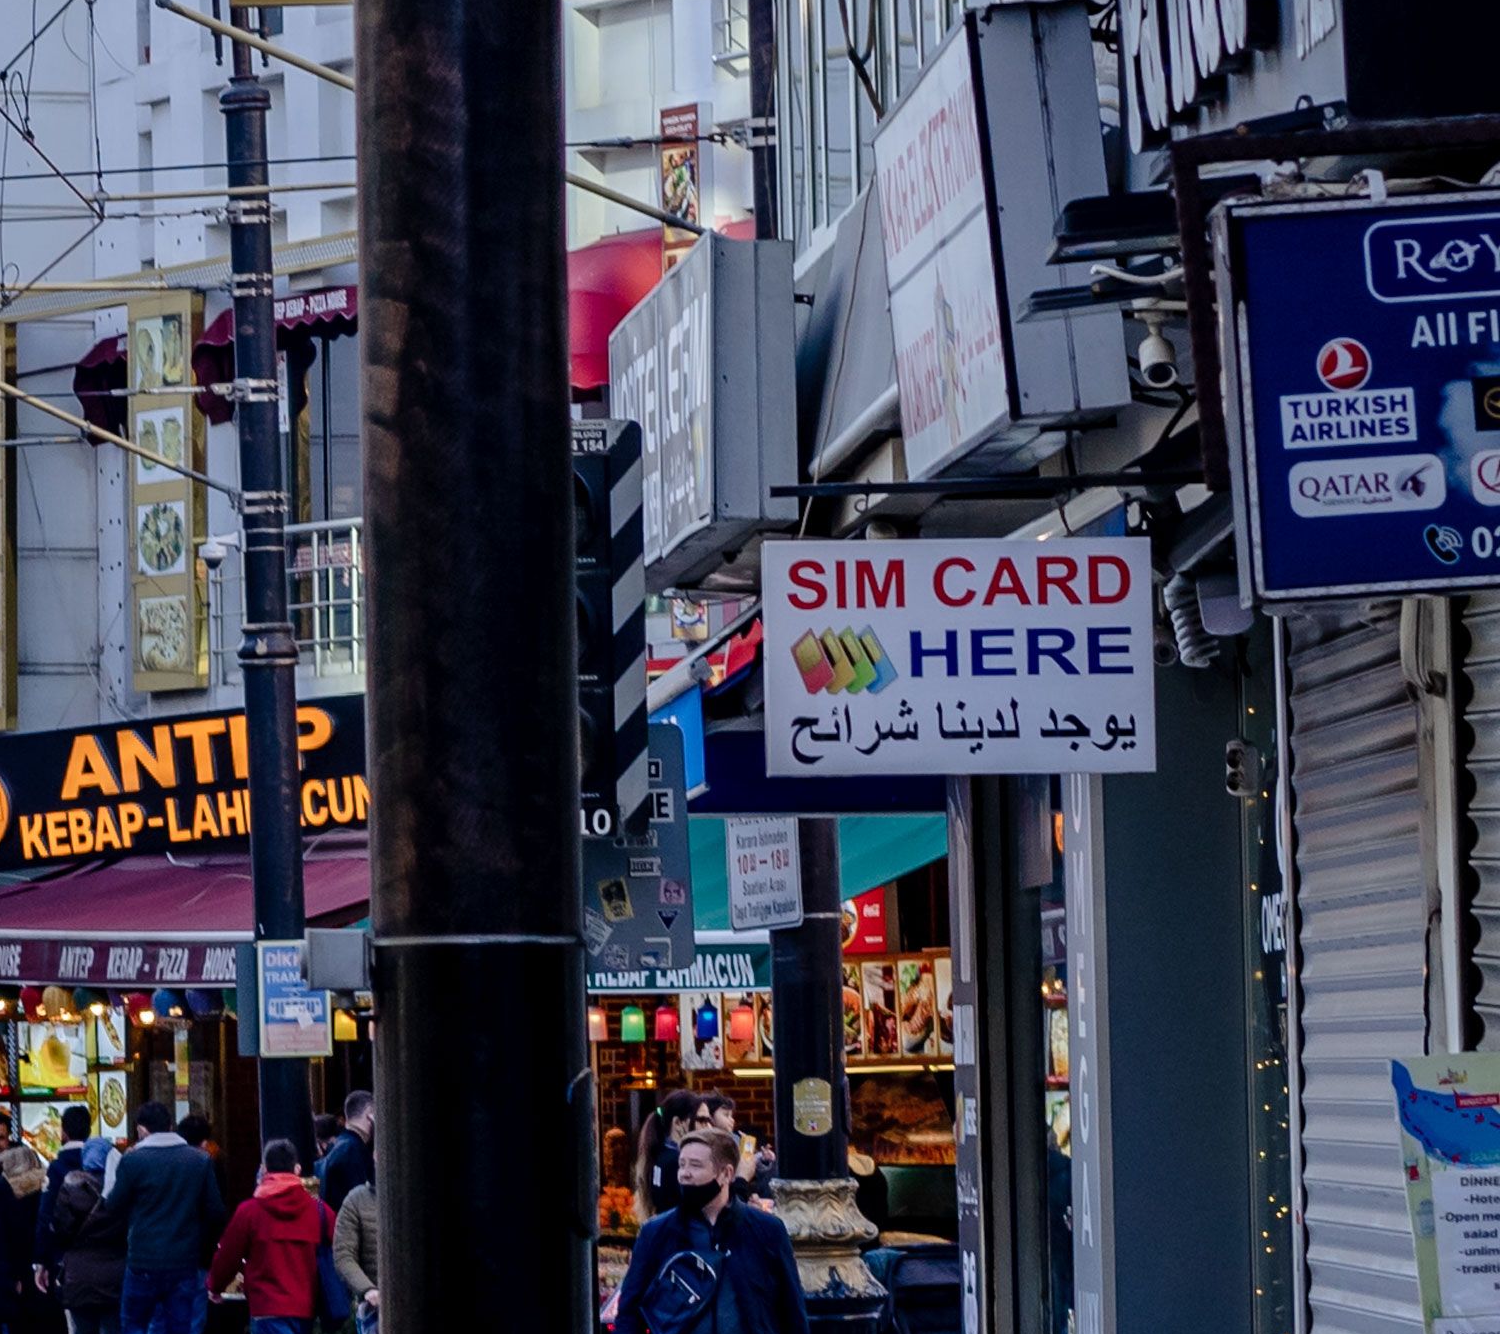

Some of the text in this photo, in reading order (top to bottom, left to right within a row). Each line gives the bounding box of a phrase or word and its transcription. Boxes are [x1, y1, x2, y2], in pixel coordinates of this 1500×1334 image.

[1411, 312, 1458, 348] All
[1288, 394, 1408, 420] TURKISH
[1291, 417, 1411, 443] AIRLINES
[1300, 473, 1391, 500] QATAR
[787, 555, 1131, 610] SIM CARD
[909, 626, 1134, 678] HERE
[790, 696, 1137, 765] يوجد لدينا شرائح
[61, 708, 333, 800] ANTP
[58, 947, 94, 979] ANTEP
[106, 948, 142, 981] KEBAP
